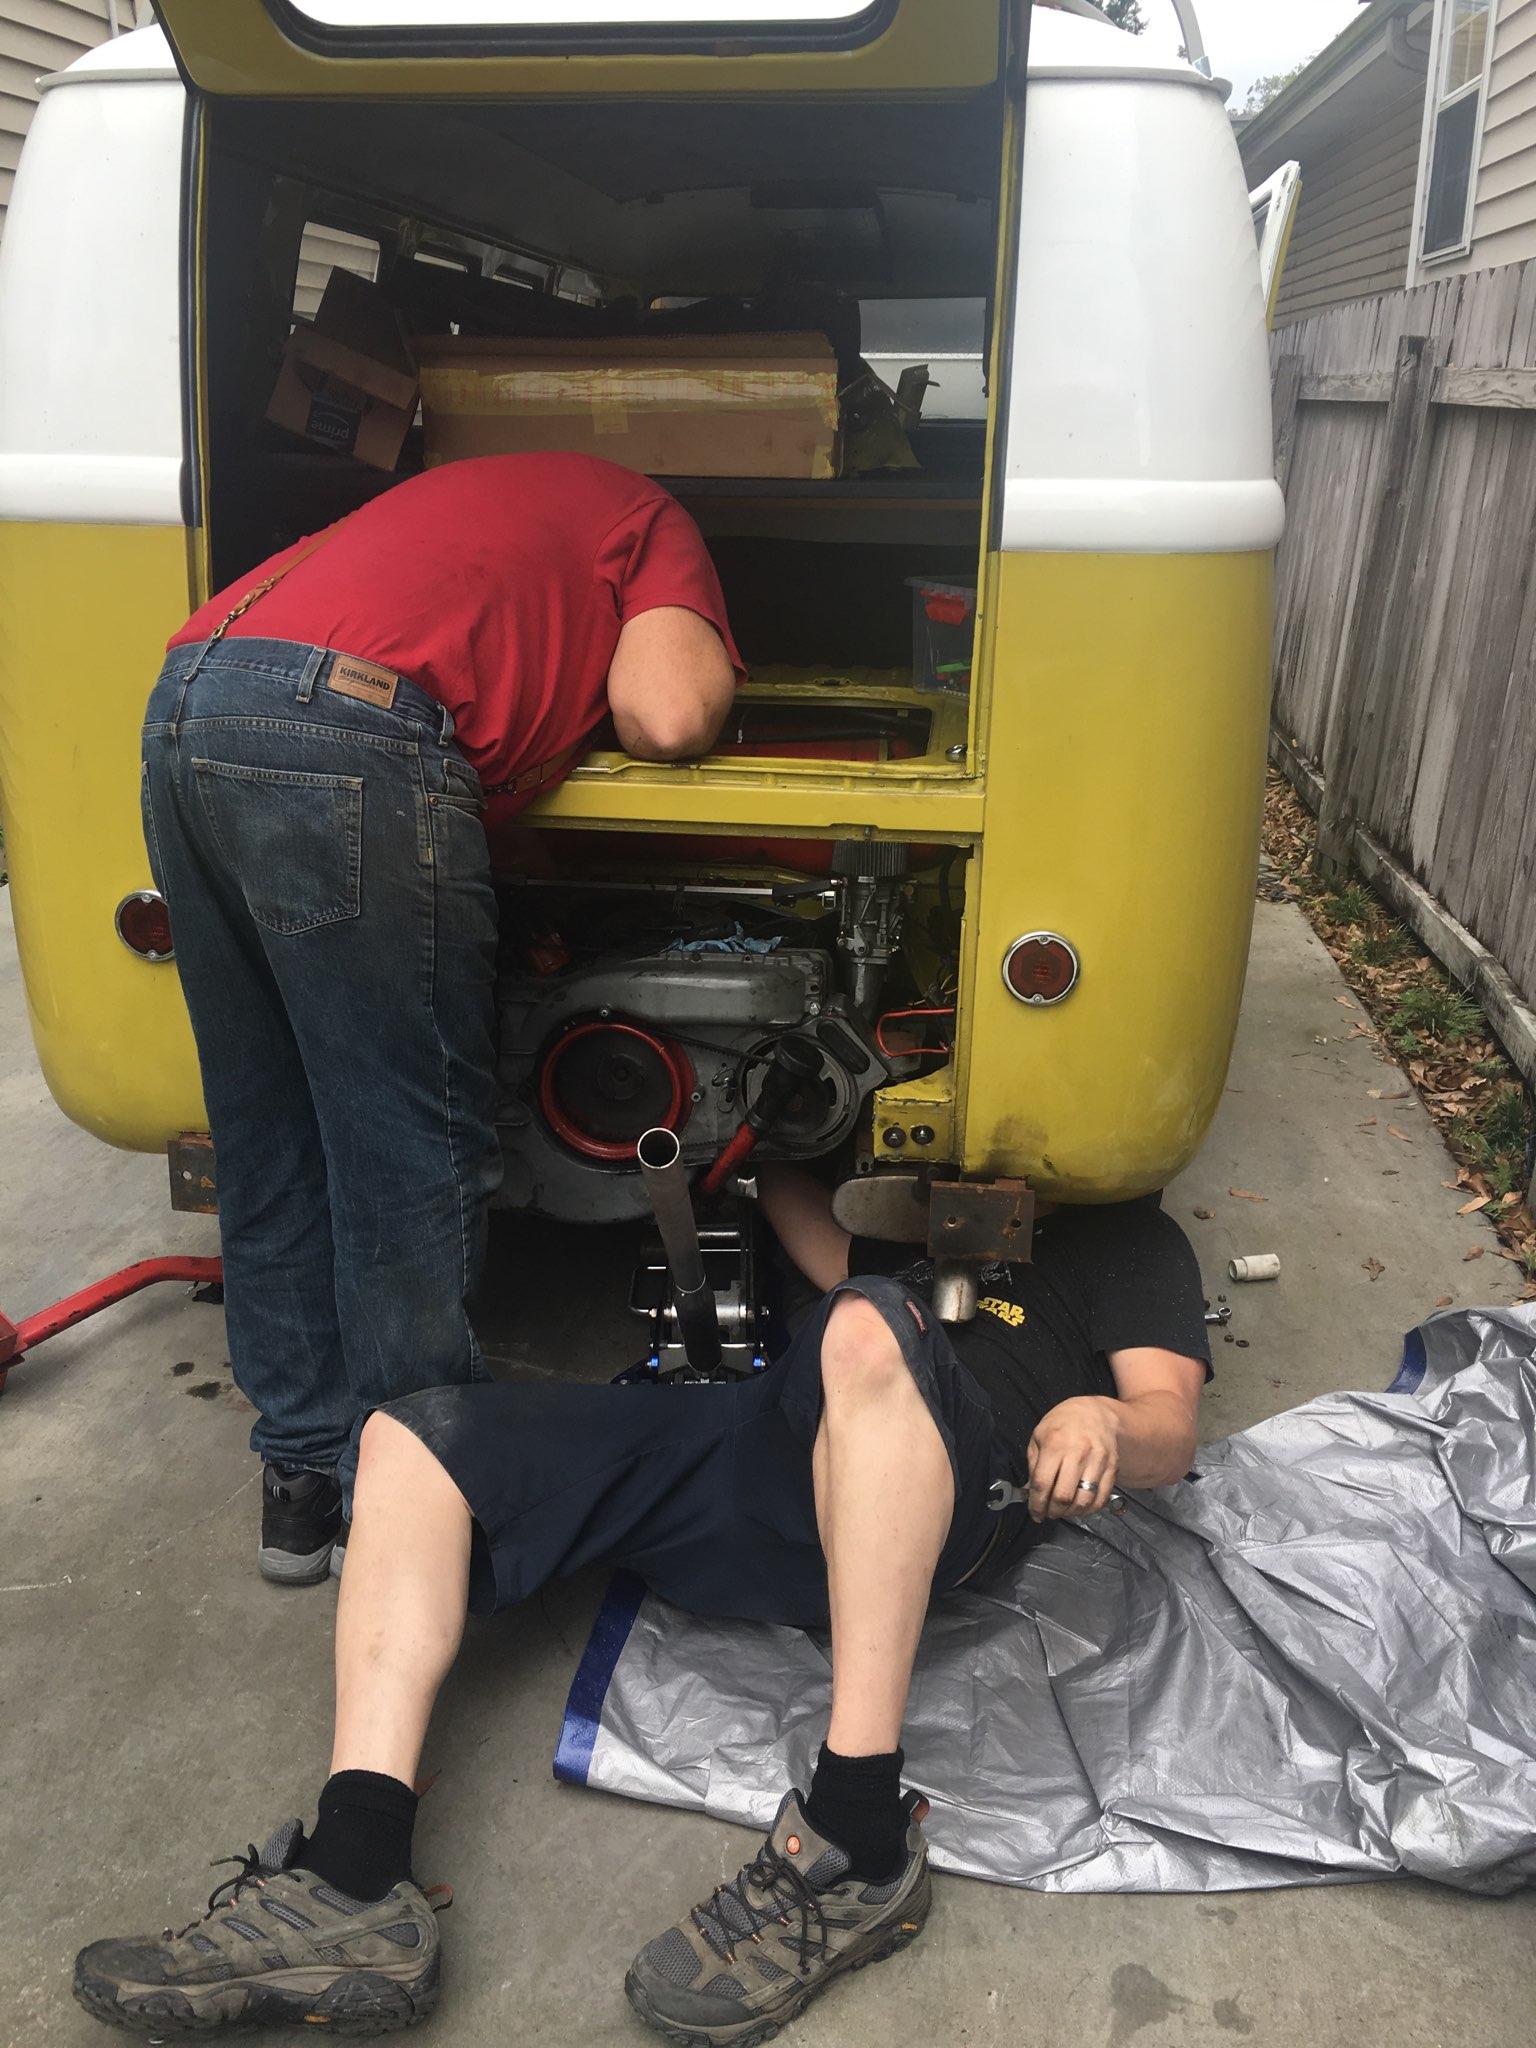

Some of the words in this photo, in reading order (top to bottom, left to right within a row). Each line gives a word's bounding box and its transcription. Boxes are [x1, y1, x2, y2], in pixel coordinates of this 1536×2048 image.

[313, 421, 350, 439] prime
[340, 667, 391, 690] KIRKLAND
[977, 1297, 1025, 1320] STAR
